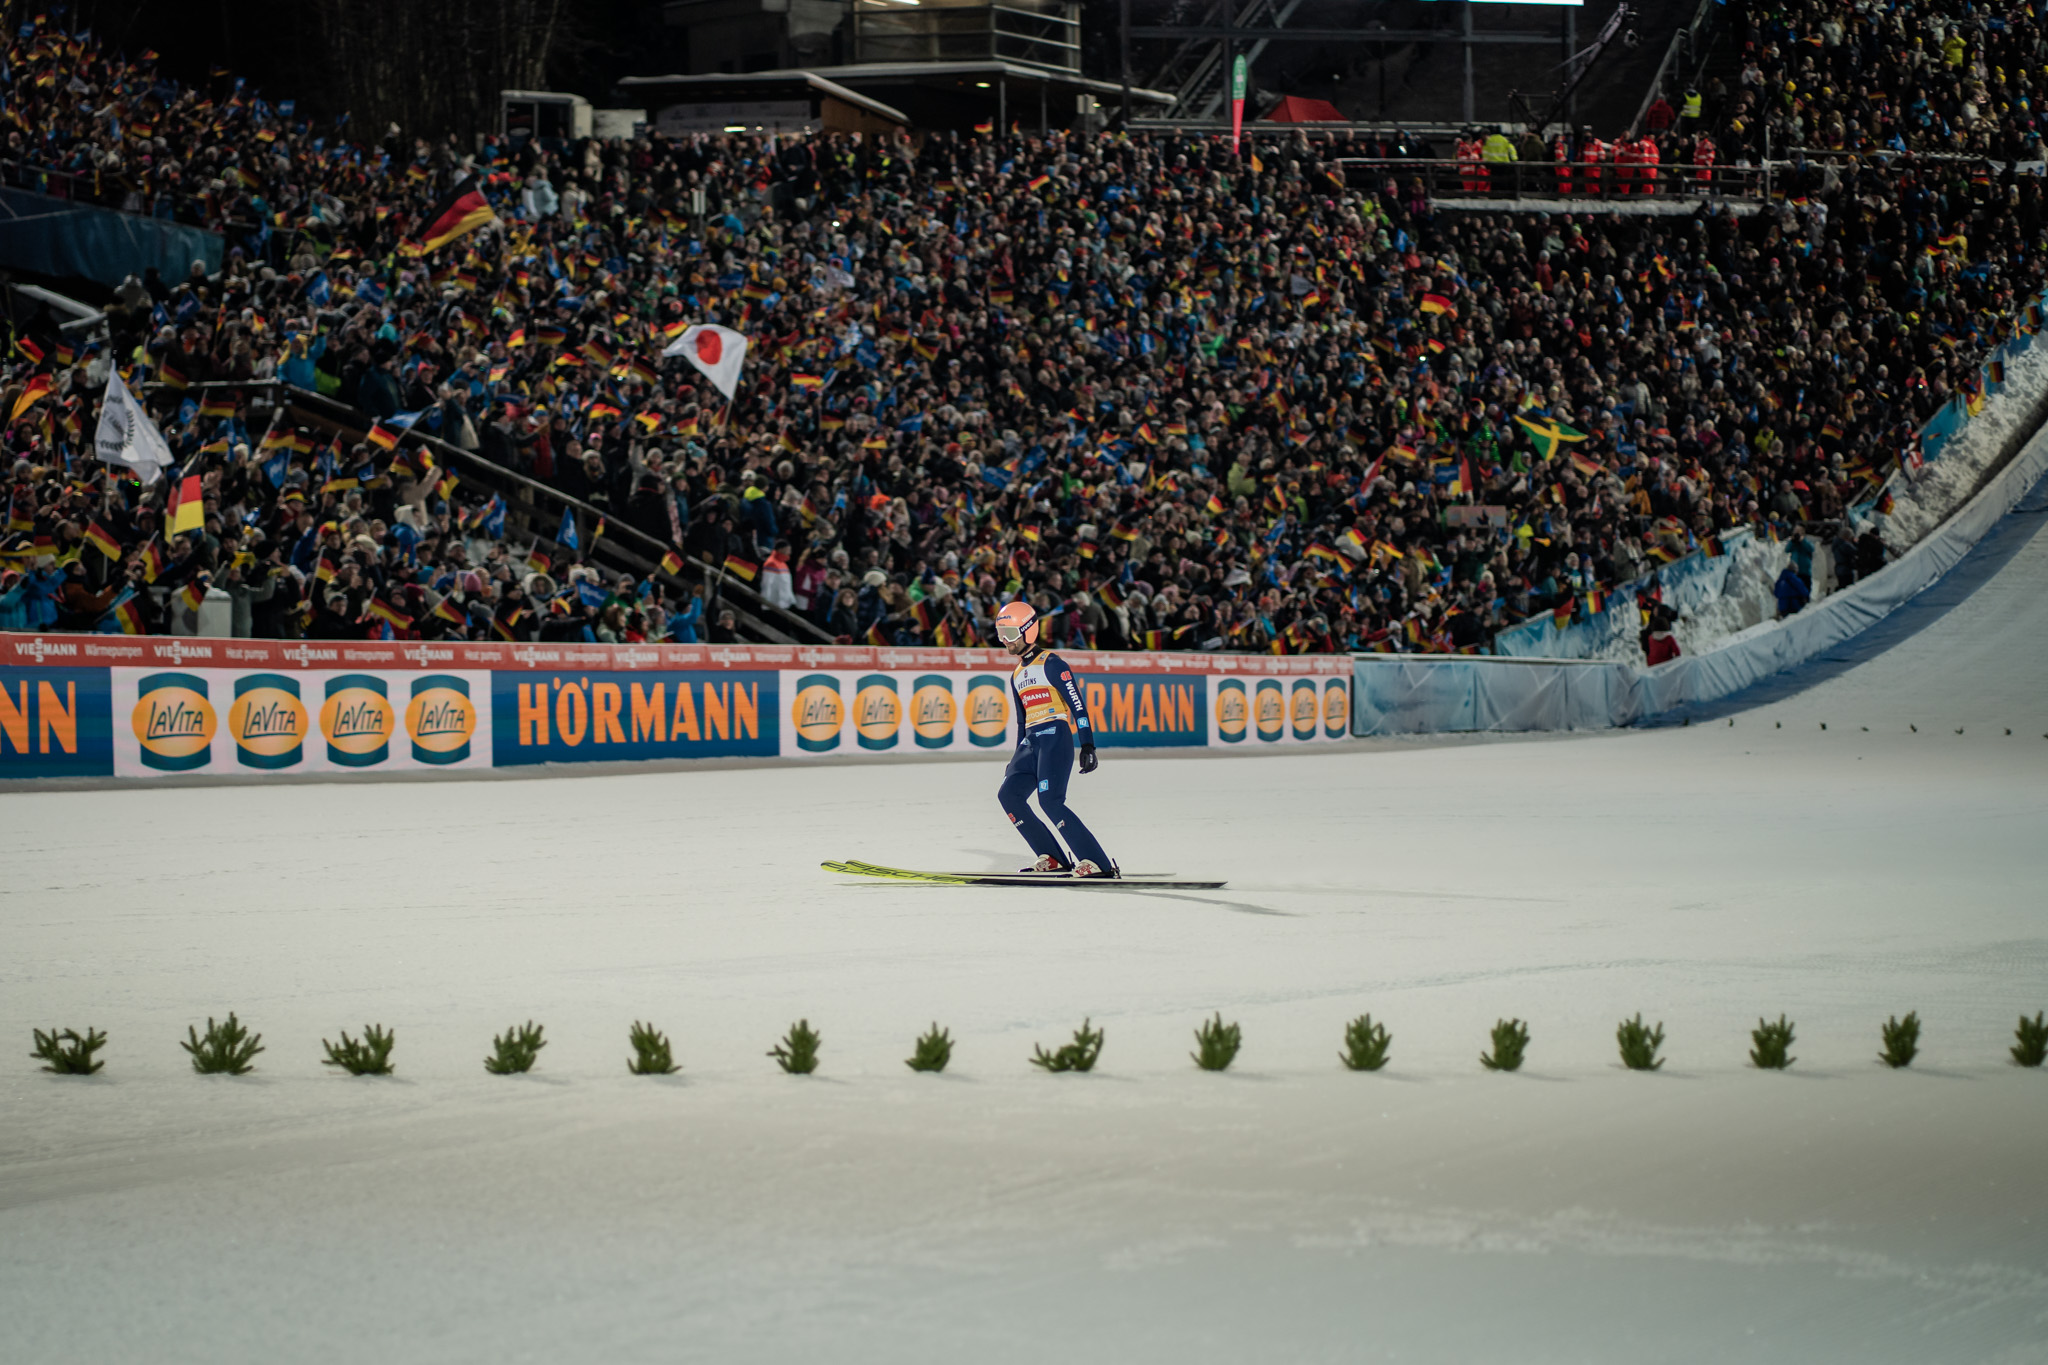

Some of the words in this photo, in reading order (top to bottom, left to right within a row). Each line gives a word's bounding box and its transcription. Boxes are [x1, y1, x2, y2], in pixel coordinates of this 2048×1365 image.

[15, 638, 77, 663] VIESSMANN
[84, 643, 143, 658] Wärmepumpen
[153, 641, 212, 664] VIESSMANN
[283, 644, 338, 667] VIESSMANN
[404, 645, 454, 667] VIESSMANN
[1017, 677, 1037, 690] VELTINS
[1065, 681, 1084, 711] WÜRTH
[146, 701, 206, 740] LAVITA
[242, 701, 298, 739] LAVITA
[333, 701, 385, 738] LAVITA
[417, 701, 467, 737] LAVITA
[518, 677, 759, 747] HÖRMANN
[1068, 678, 1196, 735] RMANN
